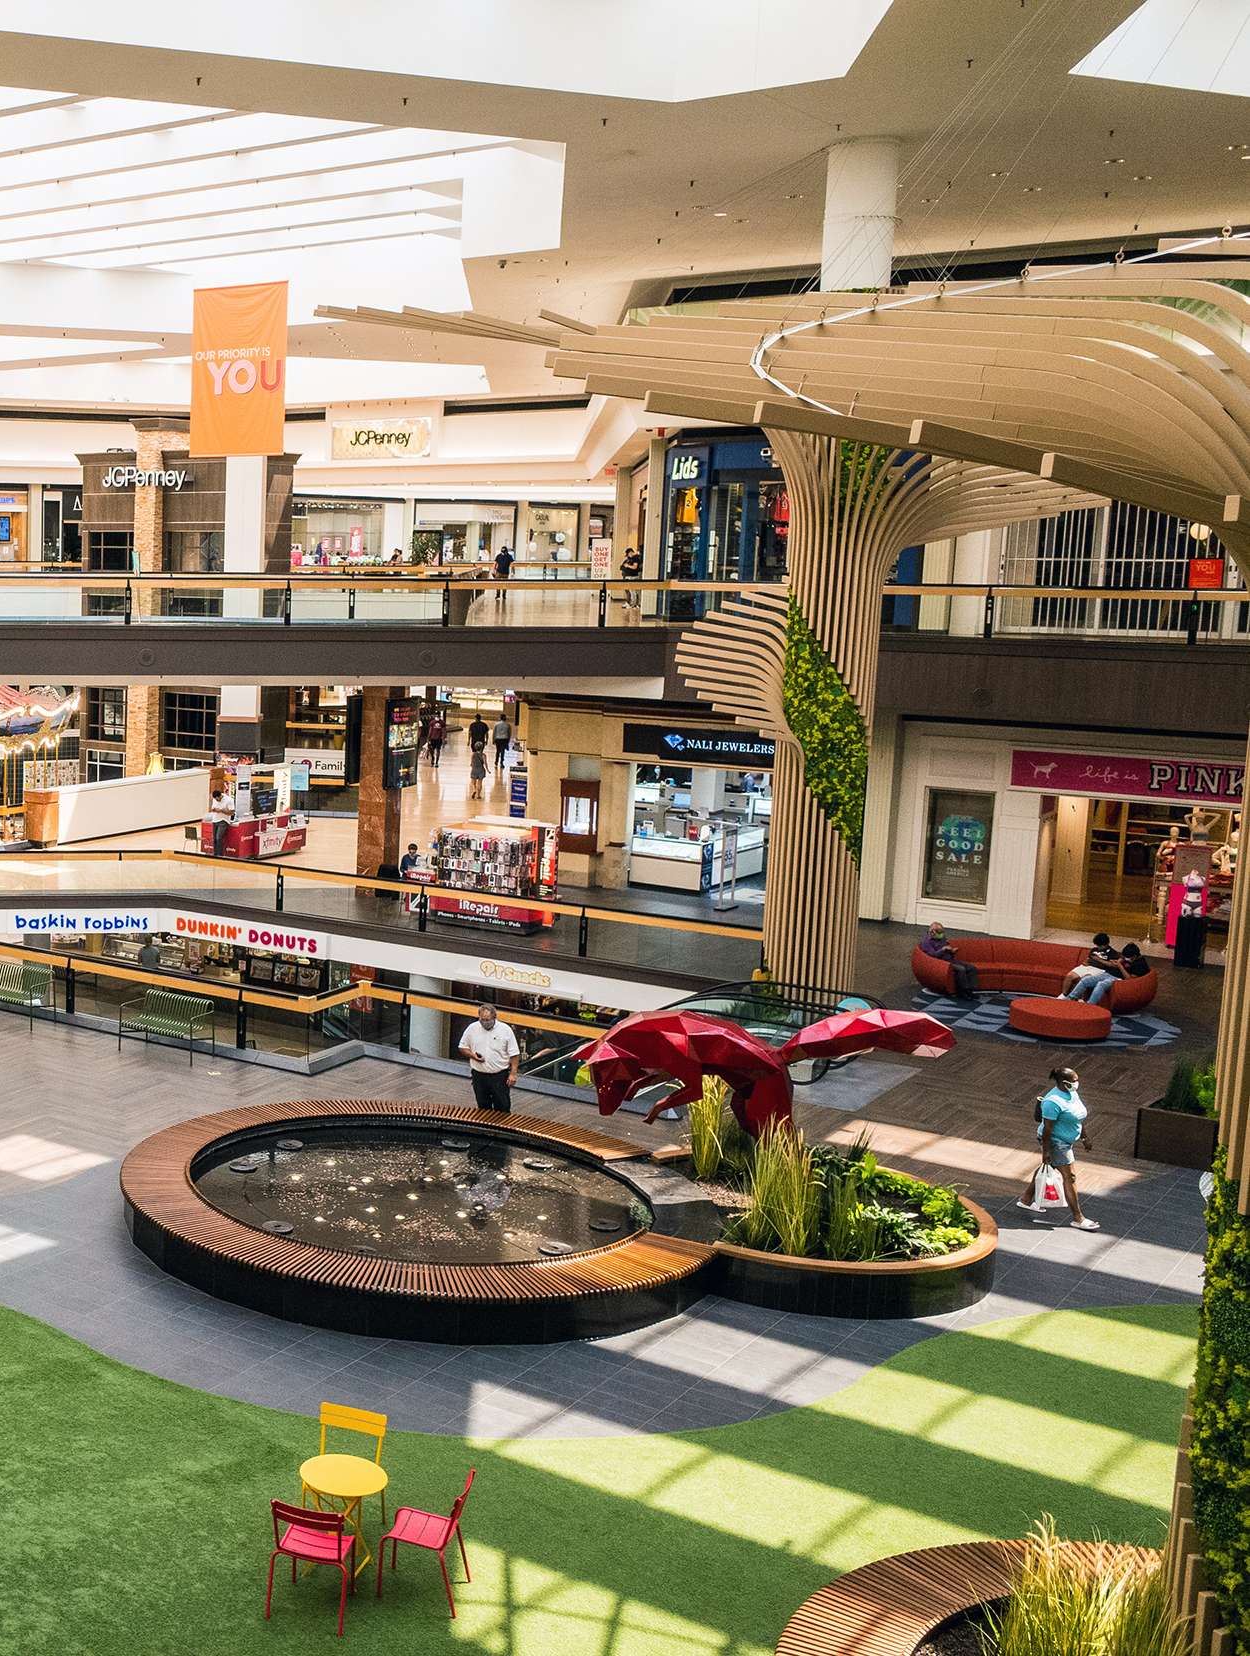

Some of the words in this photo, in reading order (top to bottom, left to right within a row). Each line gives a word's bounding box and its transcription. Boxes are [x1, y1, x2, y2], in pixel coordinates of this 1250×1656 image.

[195, 350, 216, 361] OUR
[217, 347, 261, 360] PRIORITY
[262, 346, 271, 357] IS
[206, 359, 282, 395] YOU
[349, 430, 412, 448] JCPenney
[672, 455, 699, 480] Lids
[102, 466, 186, 492] JCPenney
[686, 739, 713, 750] NALI
[715, 741, 775, 755] JEWELERS
[314, 760, 345, 771] Famil
[1078, 765, 1120, 783] life
[1123, 770, 1139, 781] is
[1149, 763, 1244, 797] PINK
[937, 825, 983, 839] FEEL
[936, 838, 984, 852] GOOD
[935, 851, 983, 865] SALE
[458, 899, 499, 915] iRepair
[14, 913, 77, 930] baskin
[83, 915, 149, 931] robbins
[176, 917, 242, 940] DUNKIN'
[248, 929, 318, 954] DONUTS
